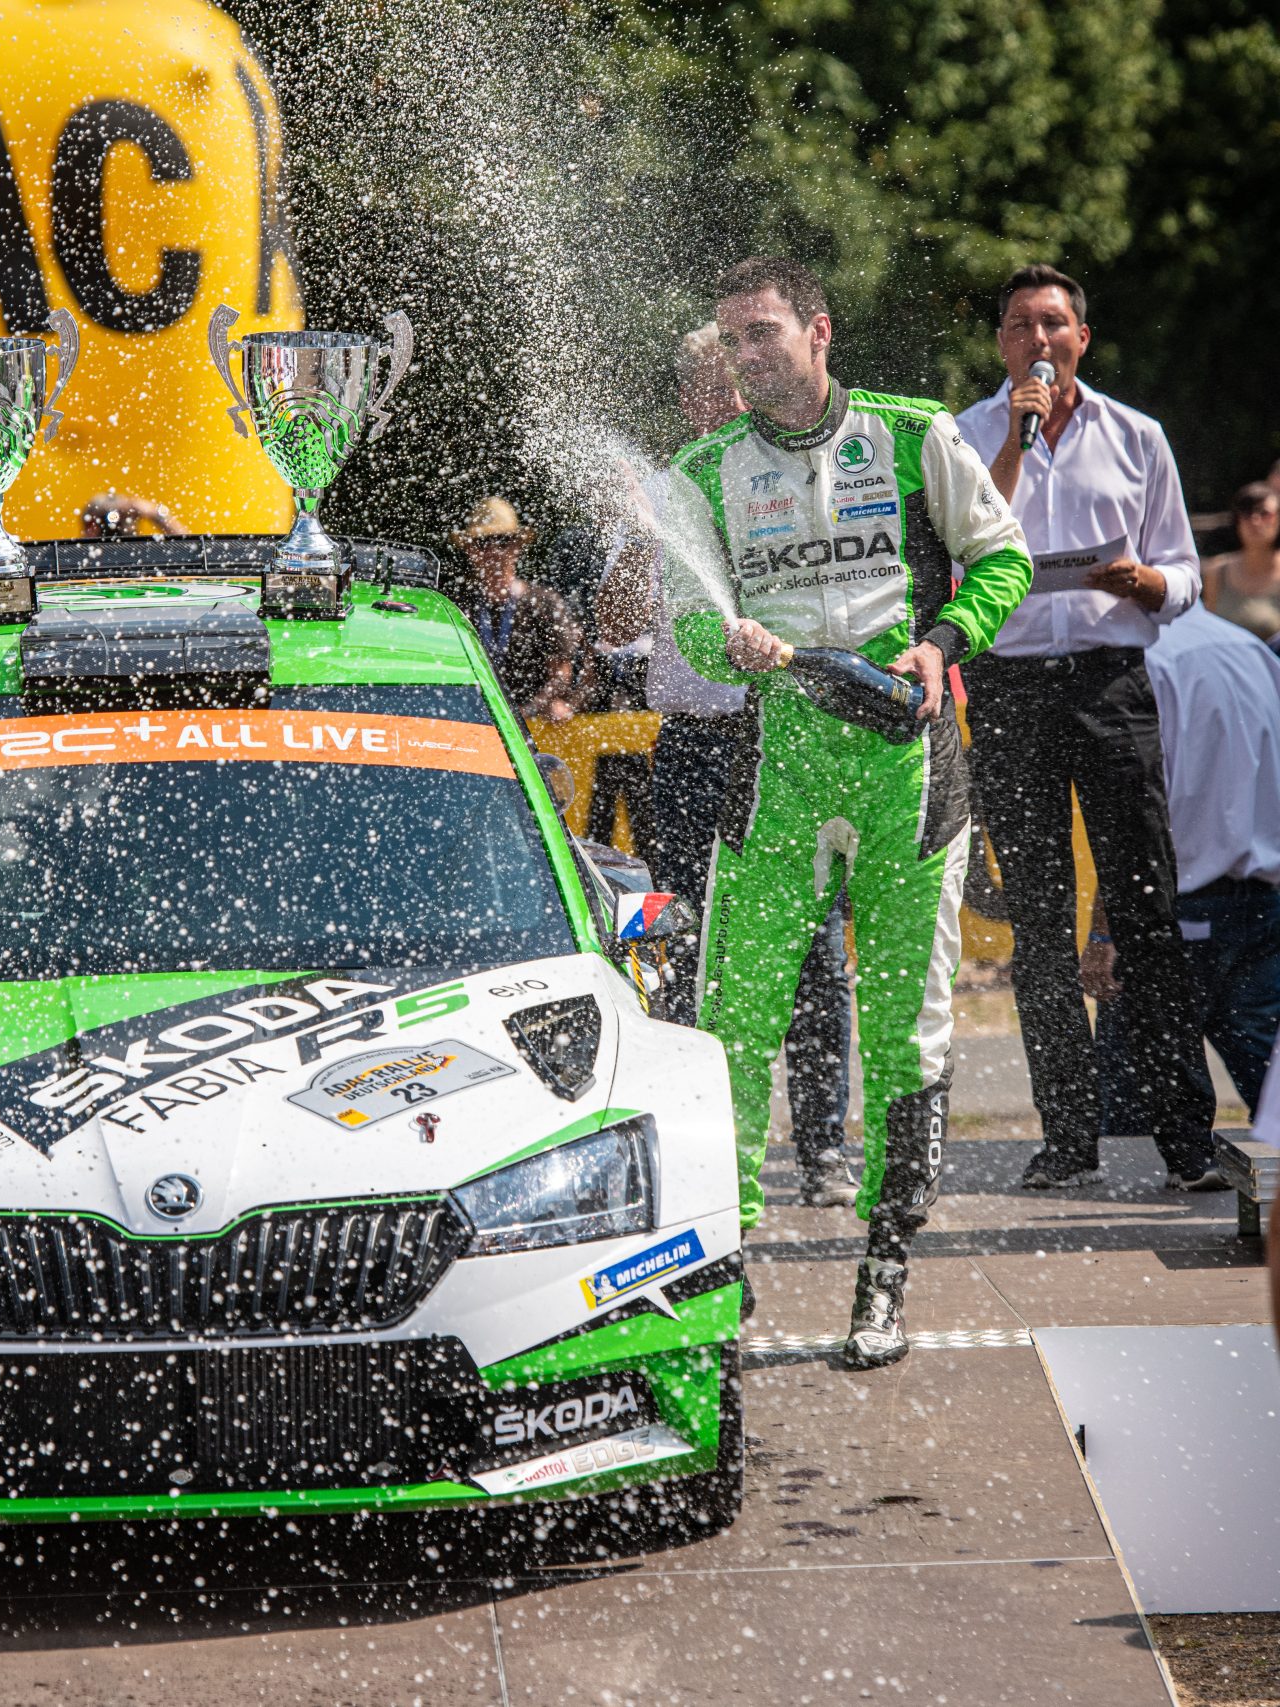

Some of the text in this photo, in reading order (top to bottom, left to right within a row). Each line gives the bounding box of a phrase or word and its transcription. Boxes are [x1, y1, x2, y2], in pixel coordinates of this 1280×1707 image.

[788, 428, 833, 449] ŠKODA
[894, 419, 926, 434] OMP
[833, 475, 886, 491] ŠKODA
[850, 505, 892, 517] MICHELIN
[738, 531, 897, 580] ŠKODA
[742, 563, 902, 599] www.skoda-auto.com
[176, 725, 390, 752] ALL LIVE
[707, 893, 732, 1032] w.skoda-auto.com
[97, 976, 549, 1134] FABIA R5 evo
[322, 1073, 374, 1098] ADAC
[371, 1050, 442, 1079] RALLYE
[343, 1065, 439, 1101] DEUTSCHLAND
[390, 1081, 439, 1105] 23
[616, 1242, 692, 1288] MICHELIN
[494, 1385, 639, 1446] ŠKODA
[571, 1431, 657, 1473] EDGE
